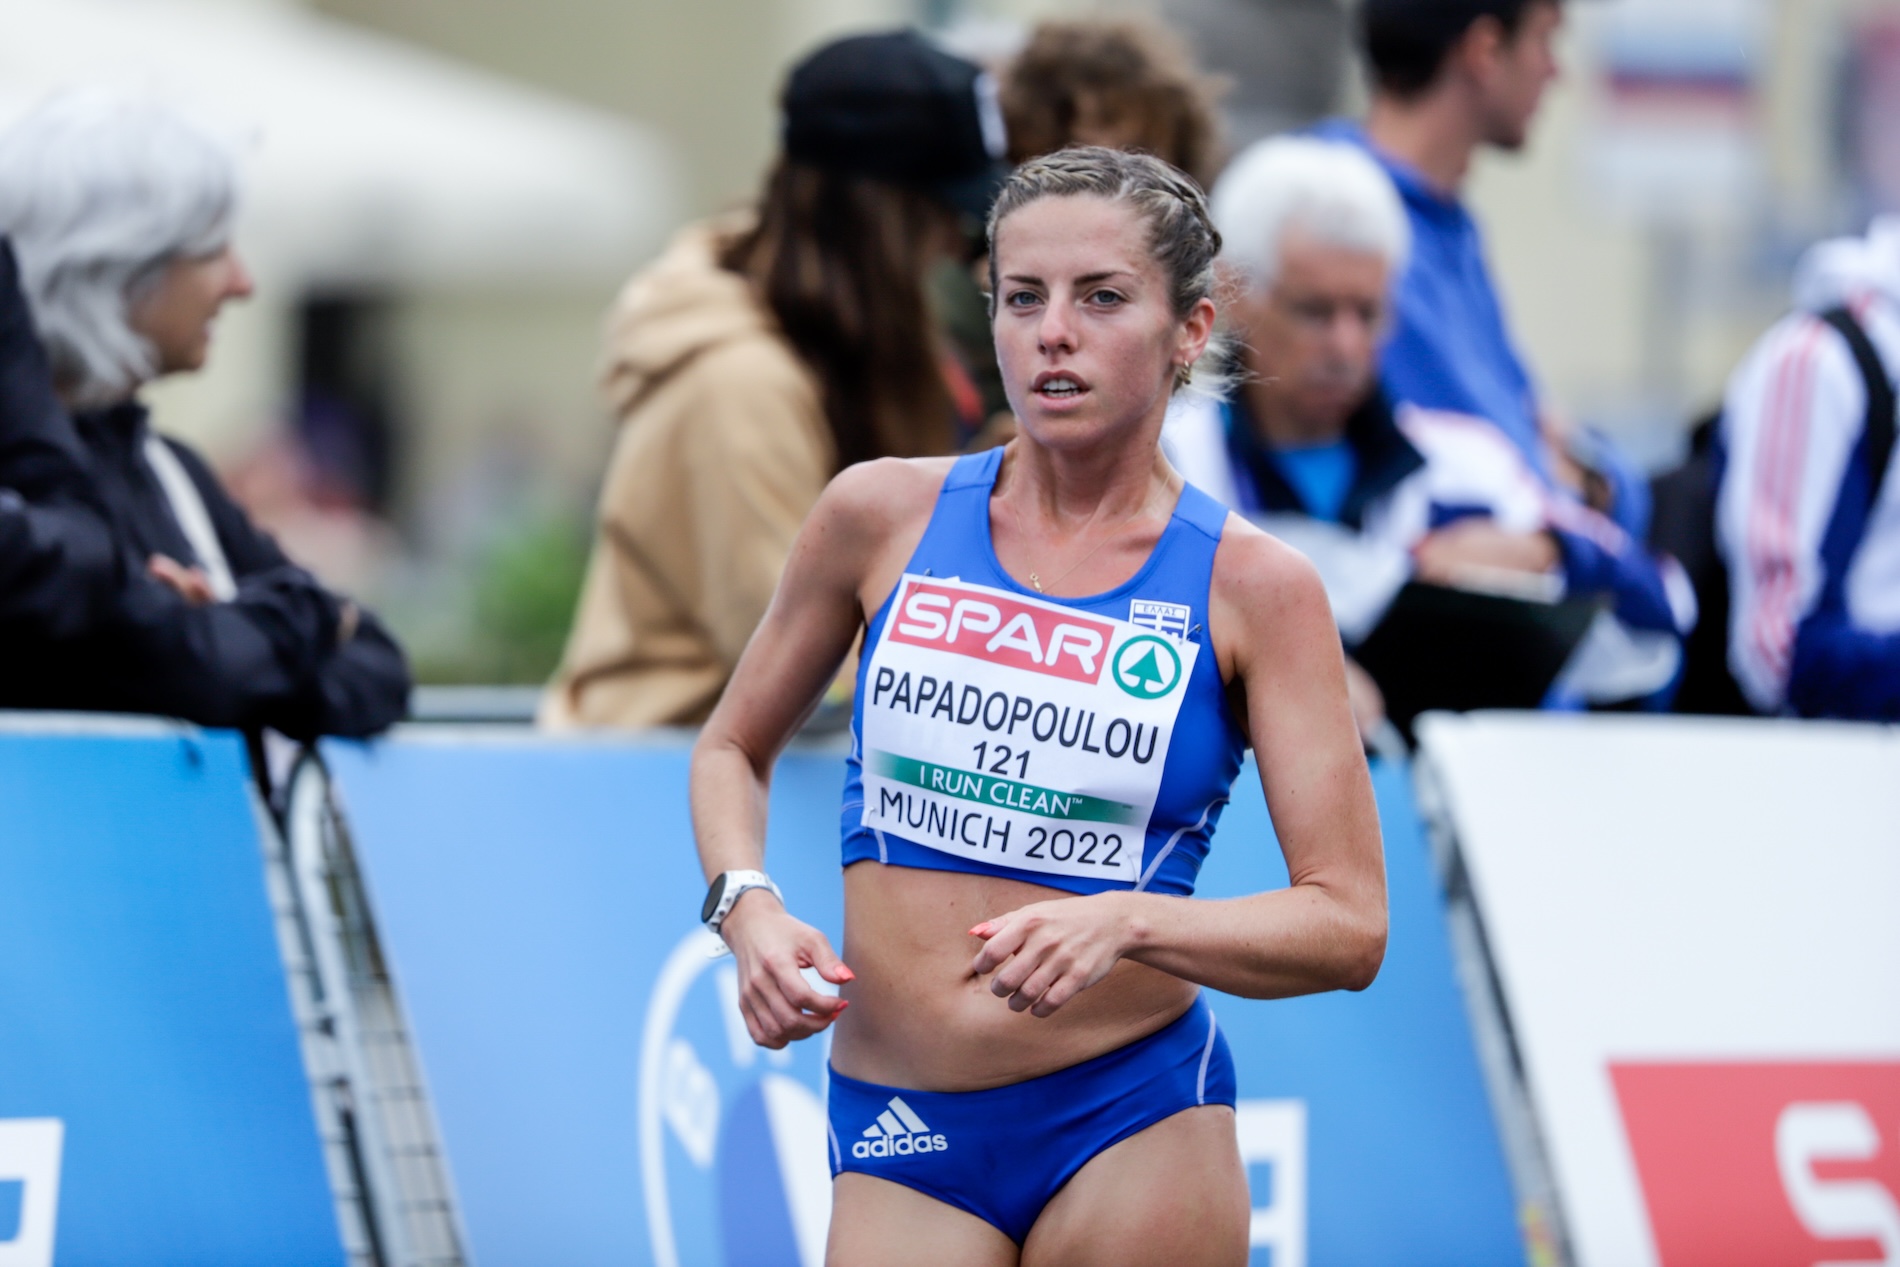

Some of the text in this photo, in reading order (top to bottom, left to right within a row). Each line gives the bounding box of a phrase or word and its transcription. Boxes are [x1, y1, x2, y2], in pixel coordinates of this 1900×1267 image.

[898, 592, 1103, 674] SPAR
[873, 666, 1158, 764] PAPADOPOULOU
[920, 765, 926, 785] I
[931, 768, 985, 799] RUN
[973, 741, 1030, 779] 121
[880, 787, 1122, 867] MUNICH 2022
[852, 1132, 948, 1159] adidas
